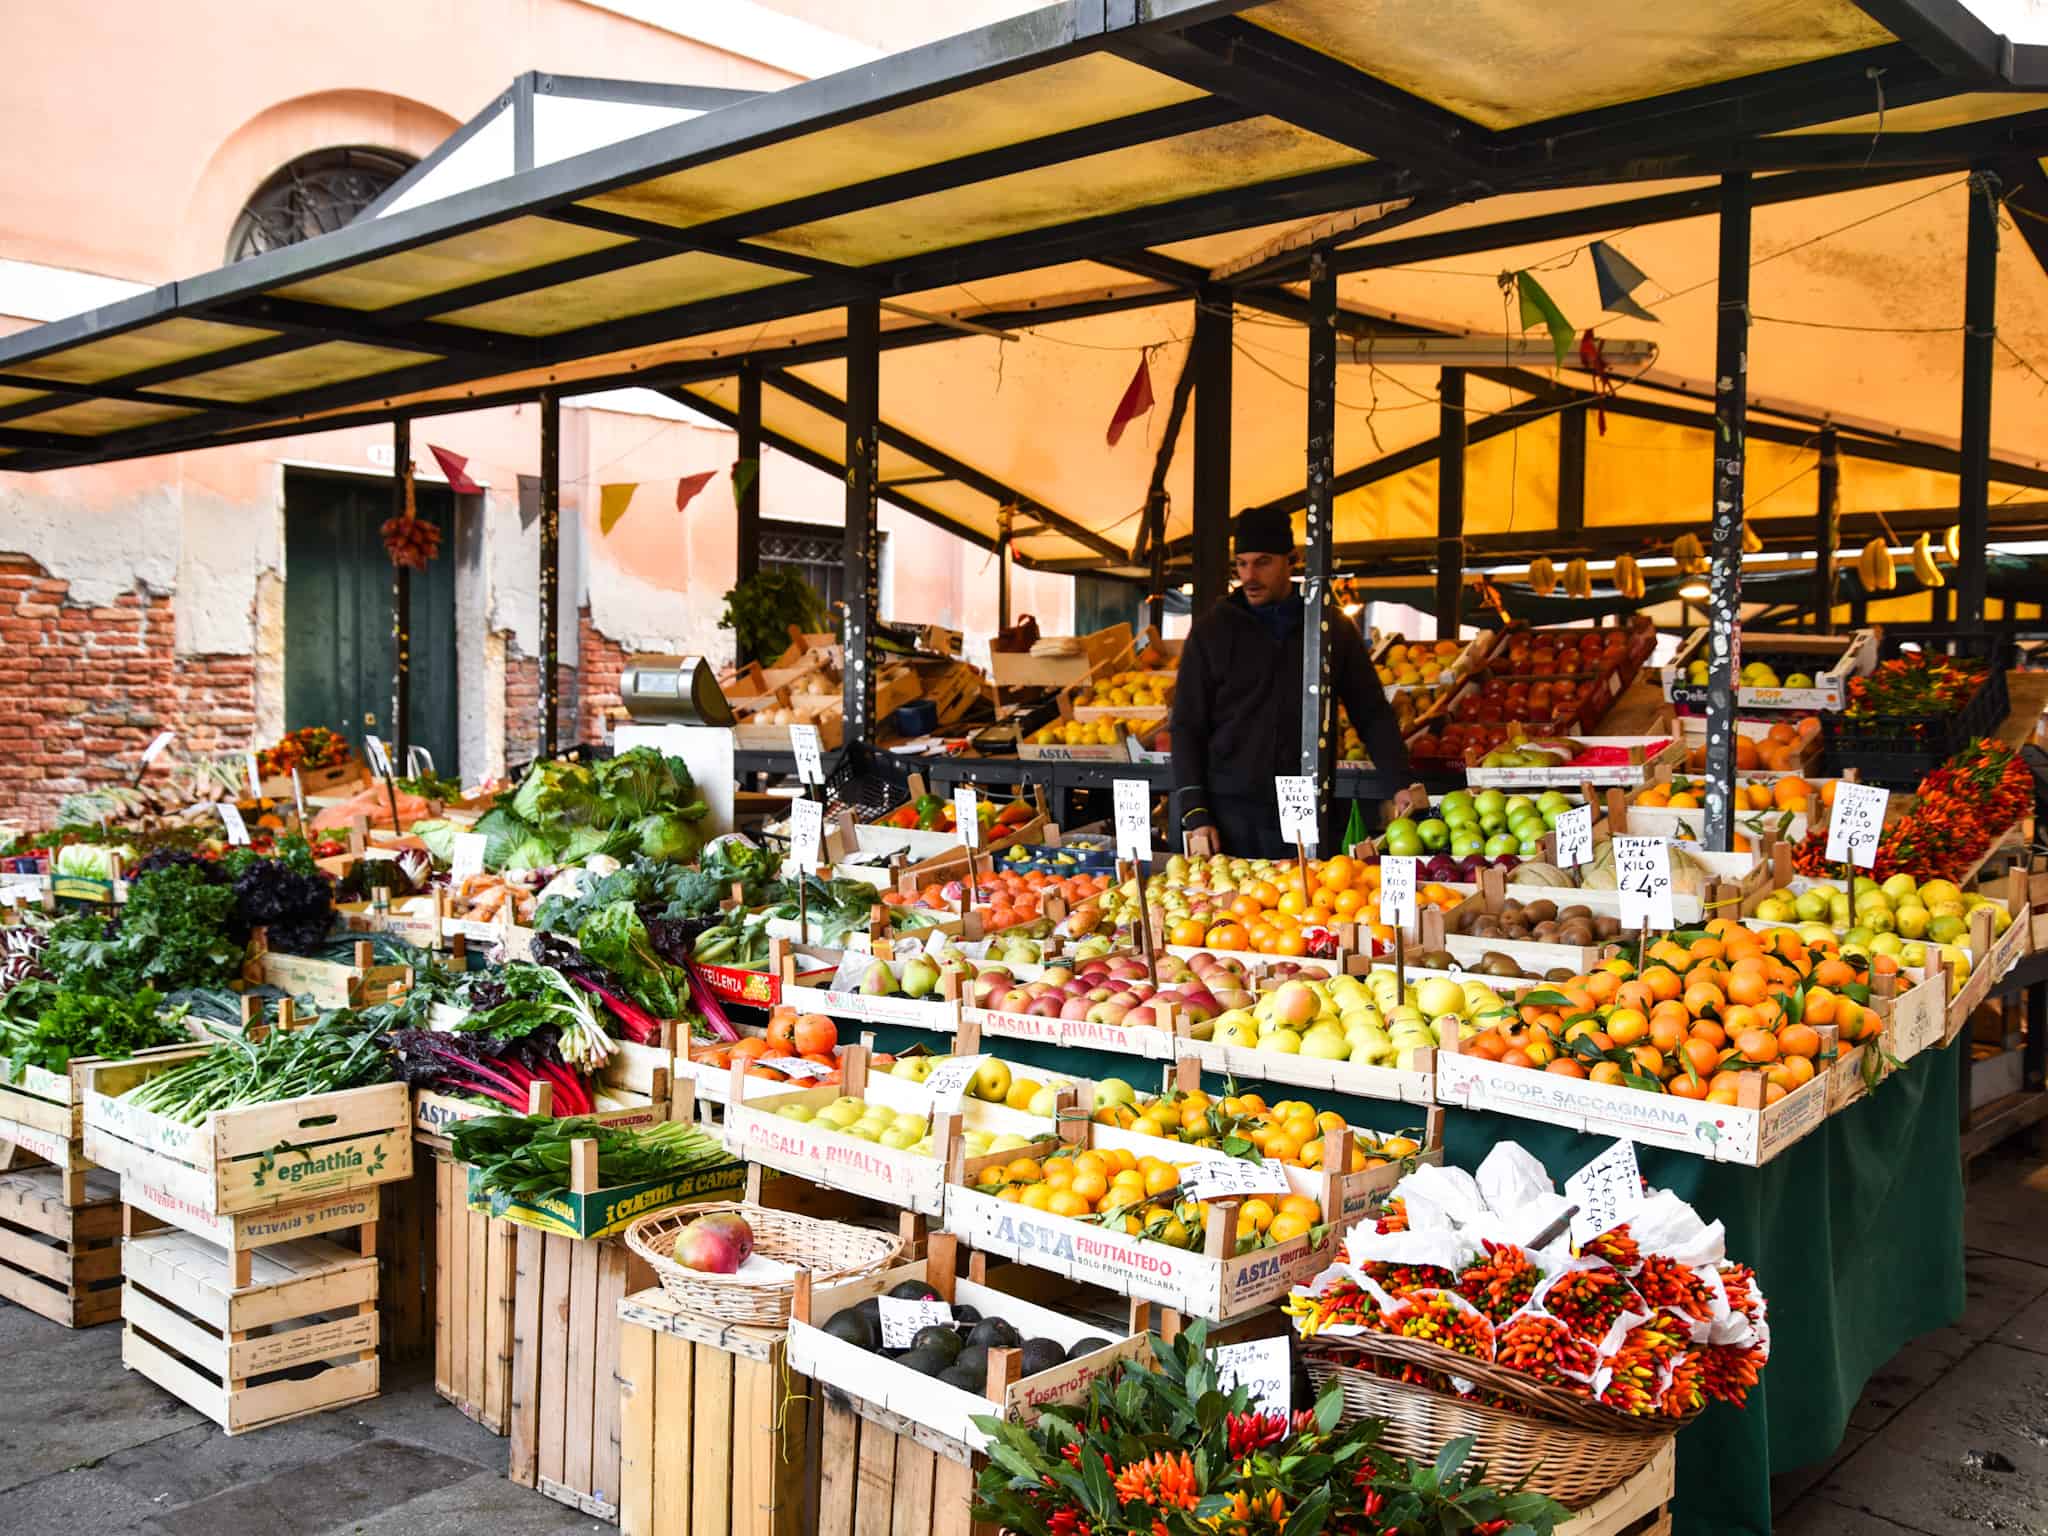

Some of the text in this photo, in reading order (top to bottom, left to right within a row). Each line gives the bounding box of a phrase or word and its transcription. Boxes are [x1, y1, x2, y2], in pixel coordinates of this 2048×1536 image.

[1039, 749, 1071, 759] ASTA
[1620, 839, 1663, 848] ITALIA
[1624, 860, 1655, 871] KILO
[987, 1012, 1128, 1047] CASALI & RIVALTA
[1552, 1090, 1689, 1127] SACCAGNANA
[278, 1147, 363, 1182] egnathia
[750, 1123, 893, 1183] CASALI & RIVALTA
[248, 1217, 301, 1236] RIVALTA
[320, 1202, 366, 1220] CASALI
[995, 1215, 1172, 1276] ASTA FRUTTALTEDO
[1078, 1257, 1175, 1292] SOLO FRUTTA ITALIANA
[1236, 1256, 1280, 1287] ASTA
